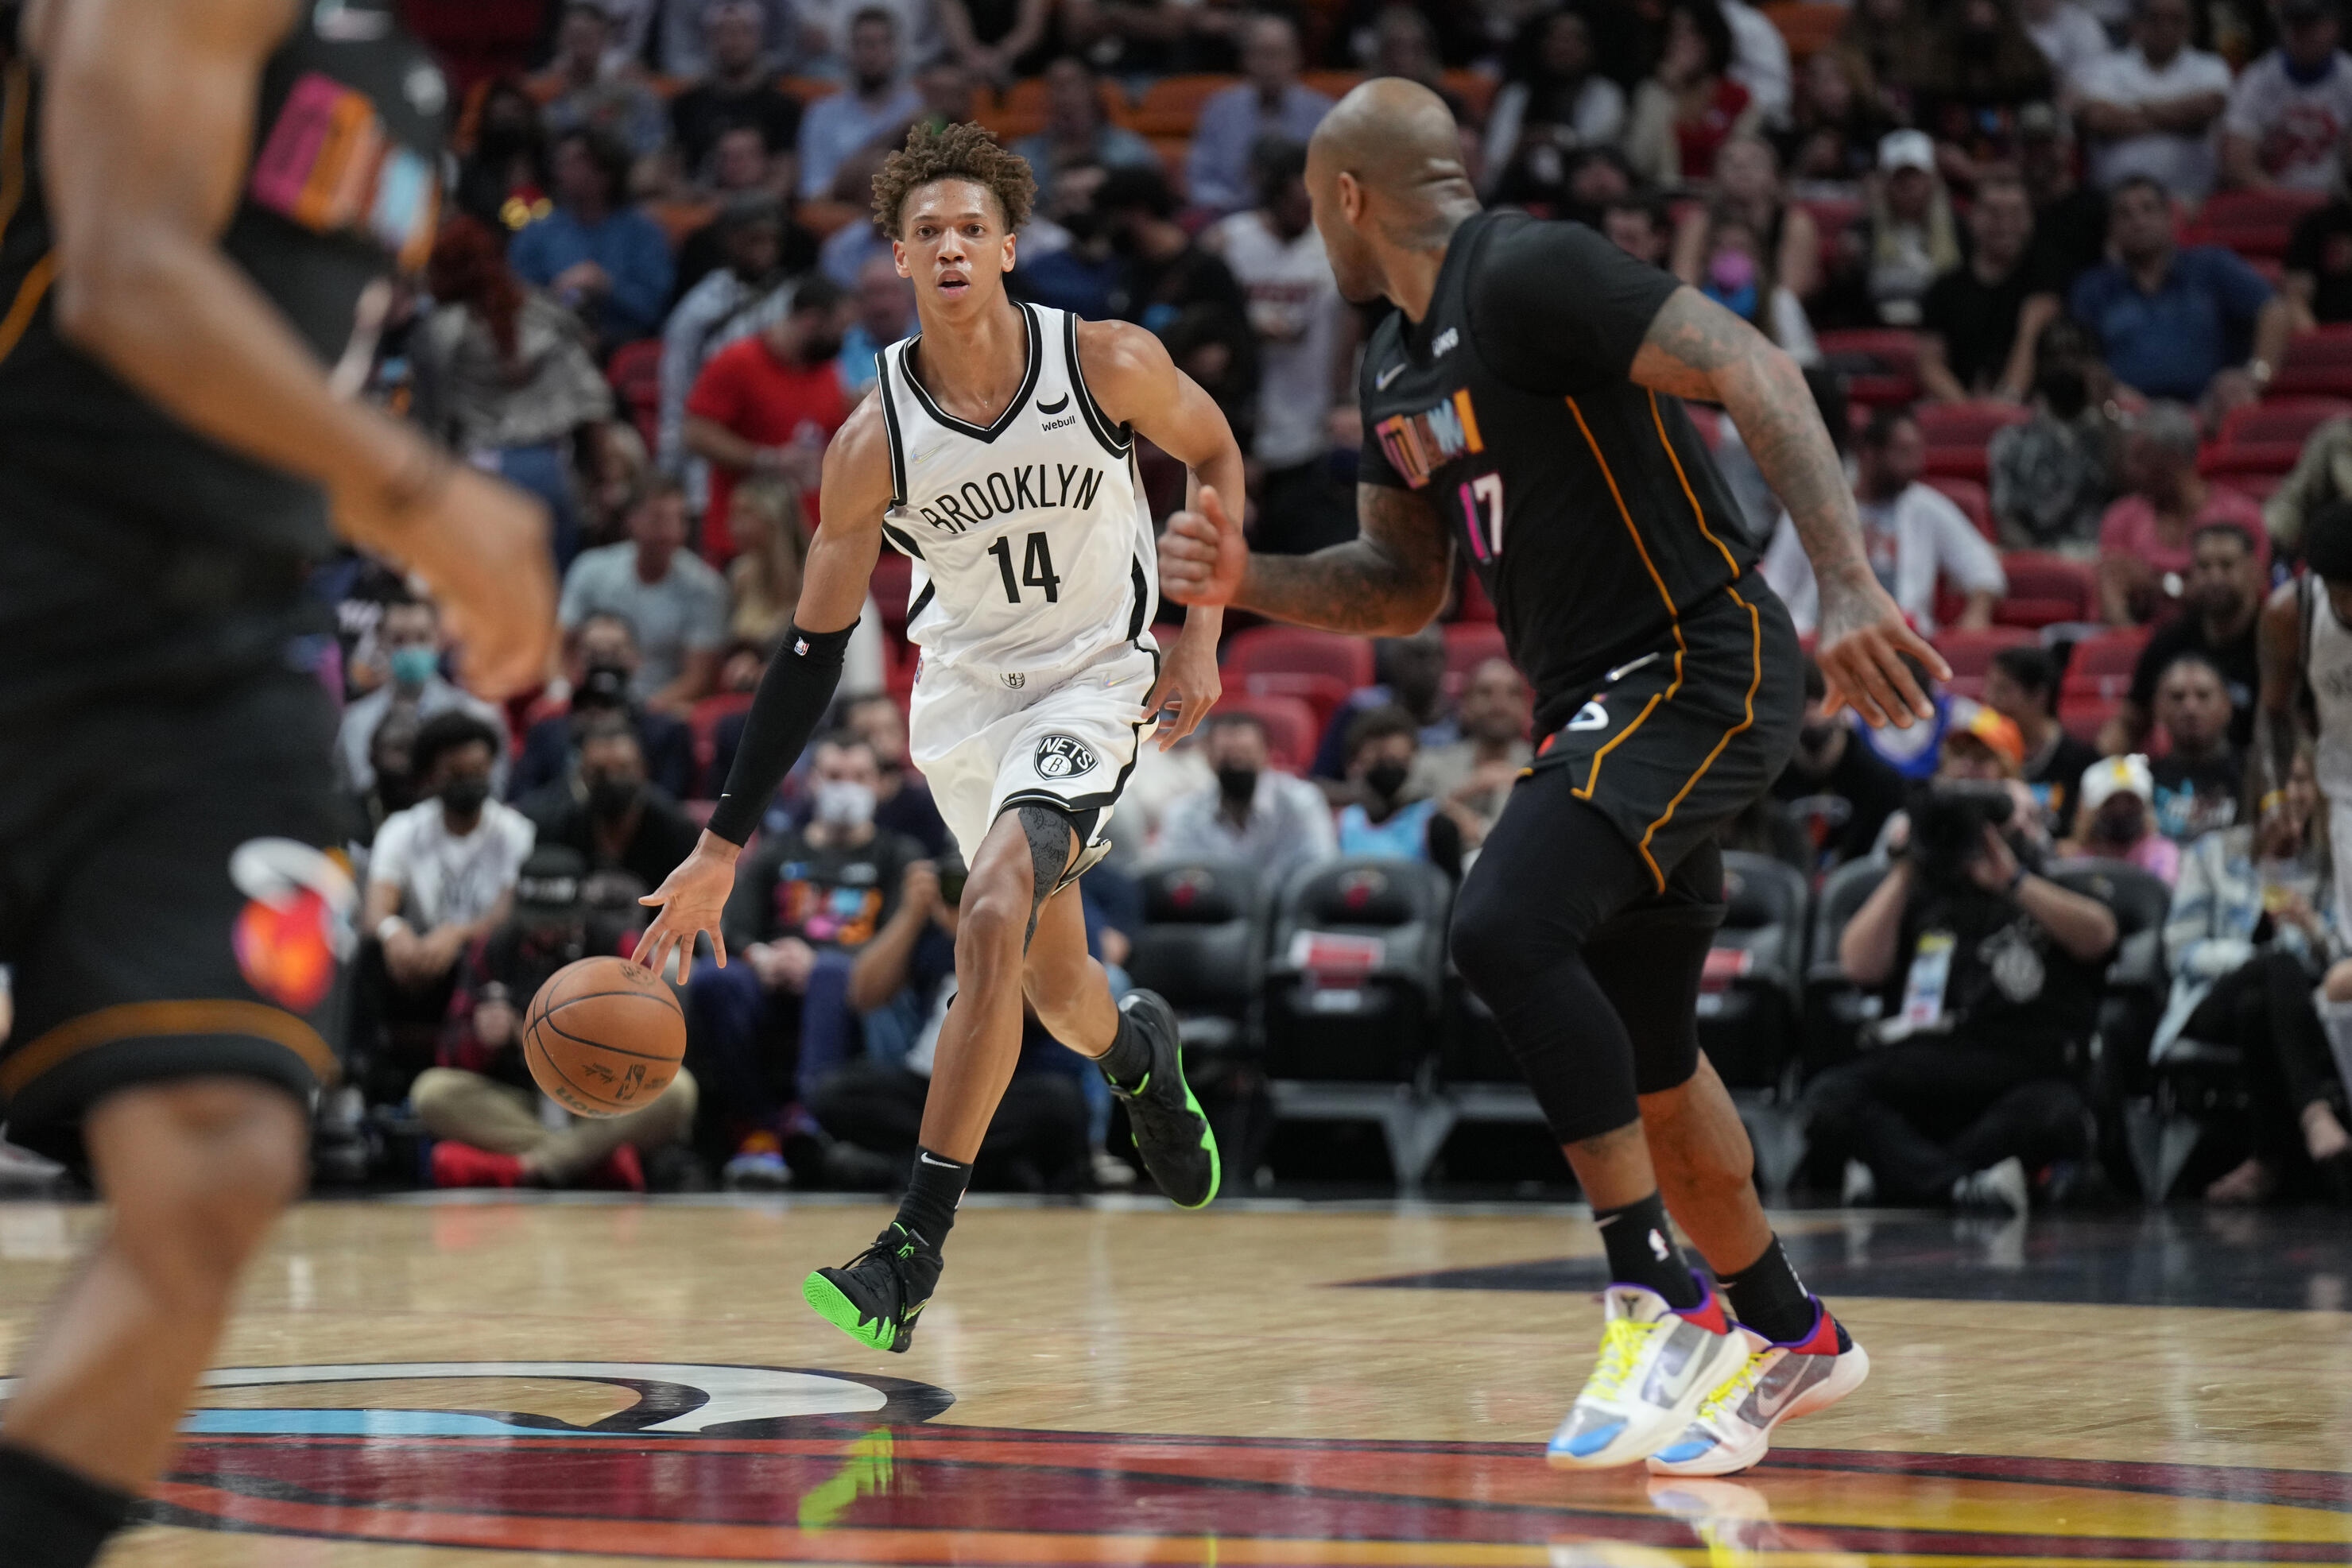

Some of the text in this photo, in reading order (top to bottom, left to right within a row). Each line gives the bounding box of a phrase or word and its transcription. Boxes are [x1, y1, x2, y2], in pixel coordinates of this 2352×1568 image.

[1041, 415, 1076, 432] Webull
[920, 463, 1104, 535] BROOKLYN
[987, 531, 1061, 604] 14
[1038, 737, 1094, 770] NETS
